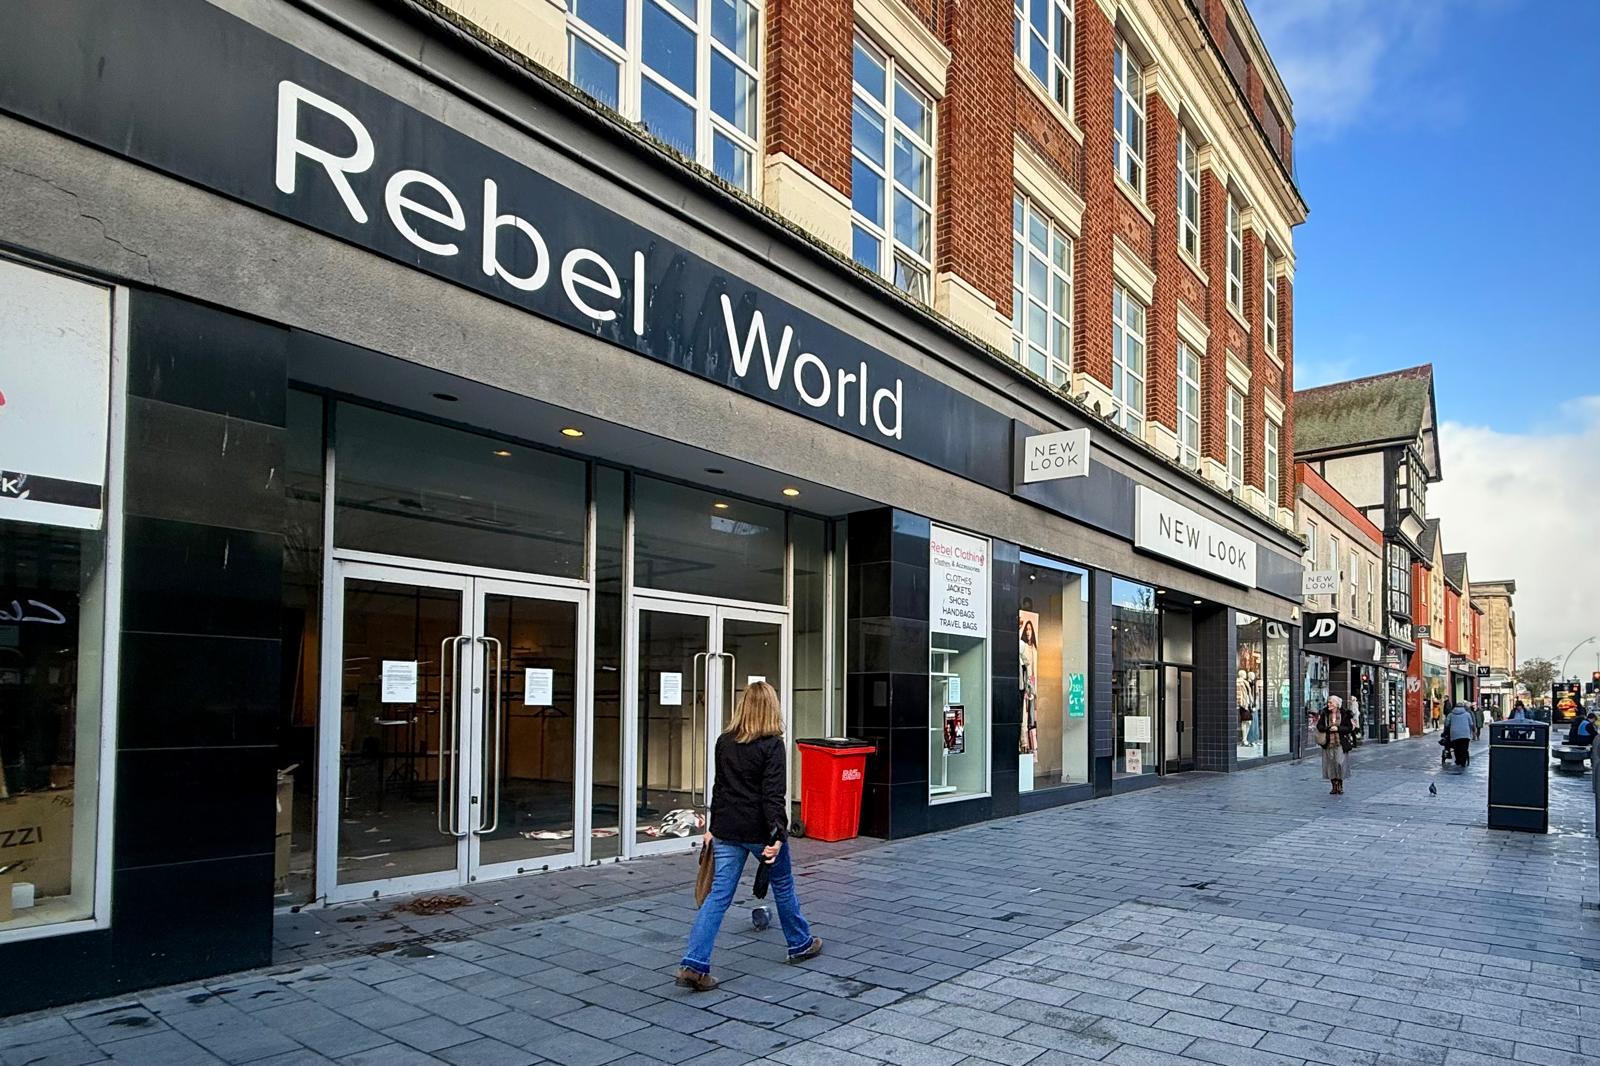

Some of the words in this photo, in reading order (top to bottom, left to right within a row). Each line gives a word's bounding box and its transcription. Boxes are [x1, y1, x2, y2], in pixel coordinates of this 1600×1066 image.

[275, 79, 645, 336] Rebel
[720, 293, 904, 441] World
[1034, 440, 1075, 457] NEW
[1030, 454, 1078, 471] LOOK
[1159, 512, 1200, 550] NEW
[1208, 535, 1247, 571] LOOK
[929, 541, 953, 557] Rebel
[954, 547, 986, 567] Clothing
[945, 572, 972, 586] CLOTHES
[1305, 582, 1335, 590] LOOK
[946, 583, 972, 596] JACKETS
[949, 595, 969, 607] SHOES
[942, 606, 975, 619] HANDBAGS
[940, 617, 961, 629] TRAVEL
[962, 621, 978, 631] BAGS
[1308, 618, 1337, 638] JD
